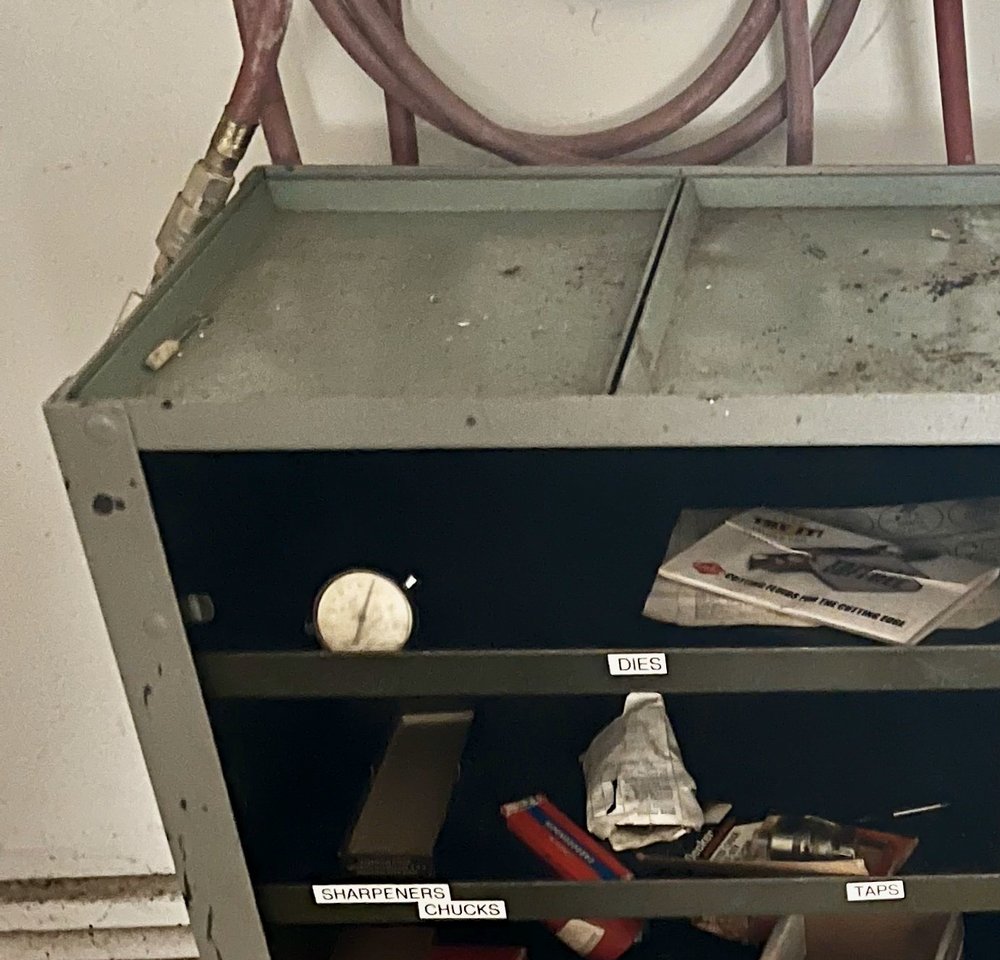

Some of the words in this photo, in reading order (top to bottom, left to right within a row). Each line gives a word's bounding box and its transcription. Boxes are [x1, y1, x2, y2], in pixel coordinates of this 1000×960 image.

[819, 598, 838, 609] THE
[838, 603, 881, 620] CUTTING
[618, 657, 662, 672] DIES
[321, 886, 446, 901] SHARPENERS
[855, 882, 900, 898] TAPS
[424, 902, 501, 917] CHUCKS
